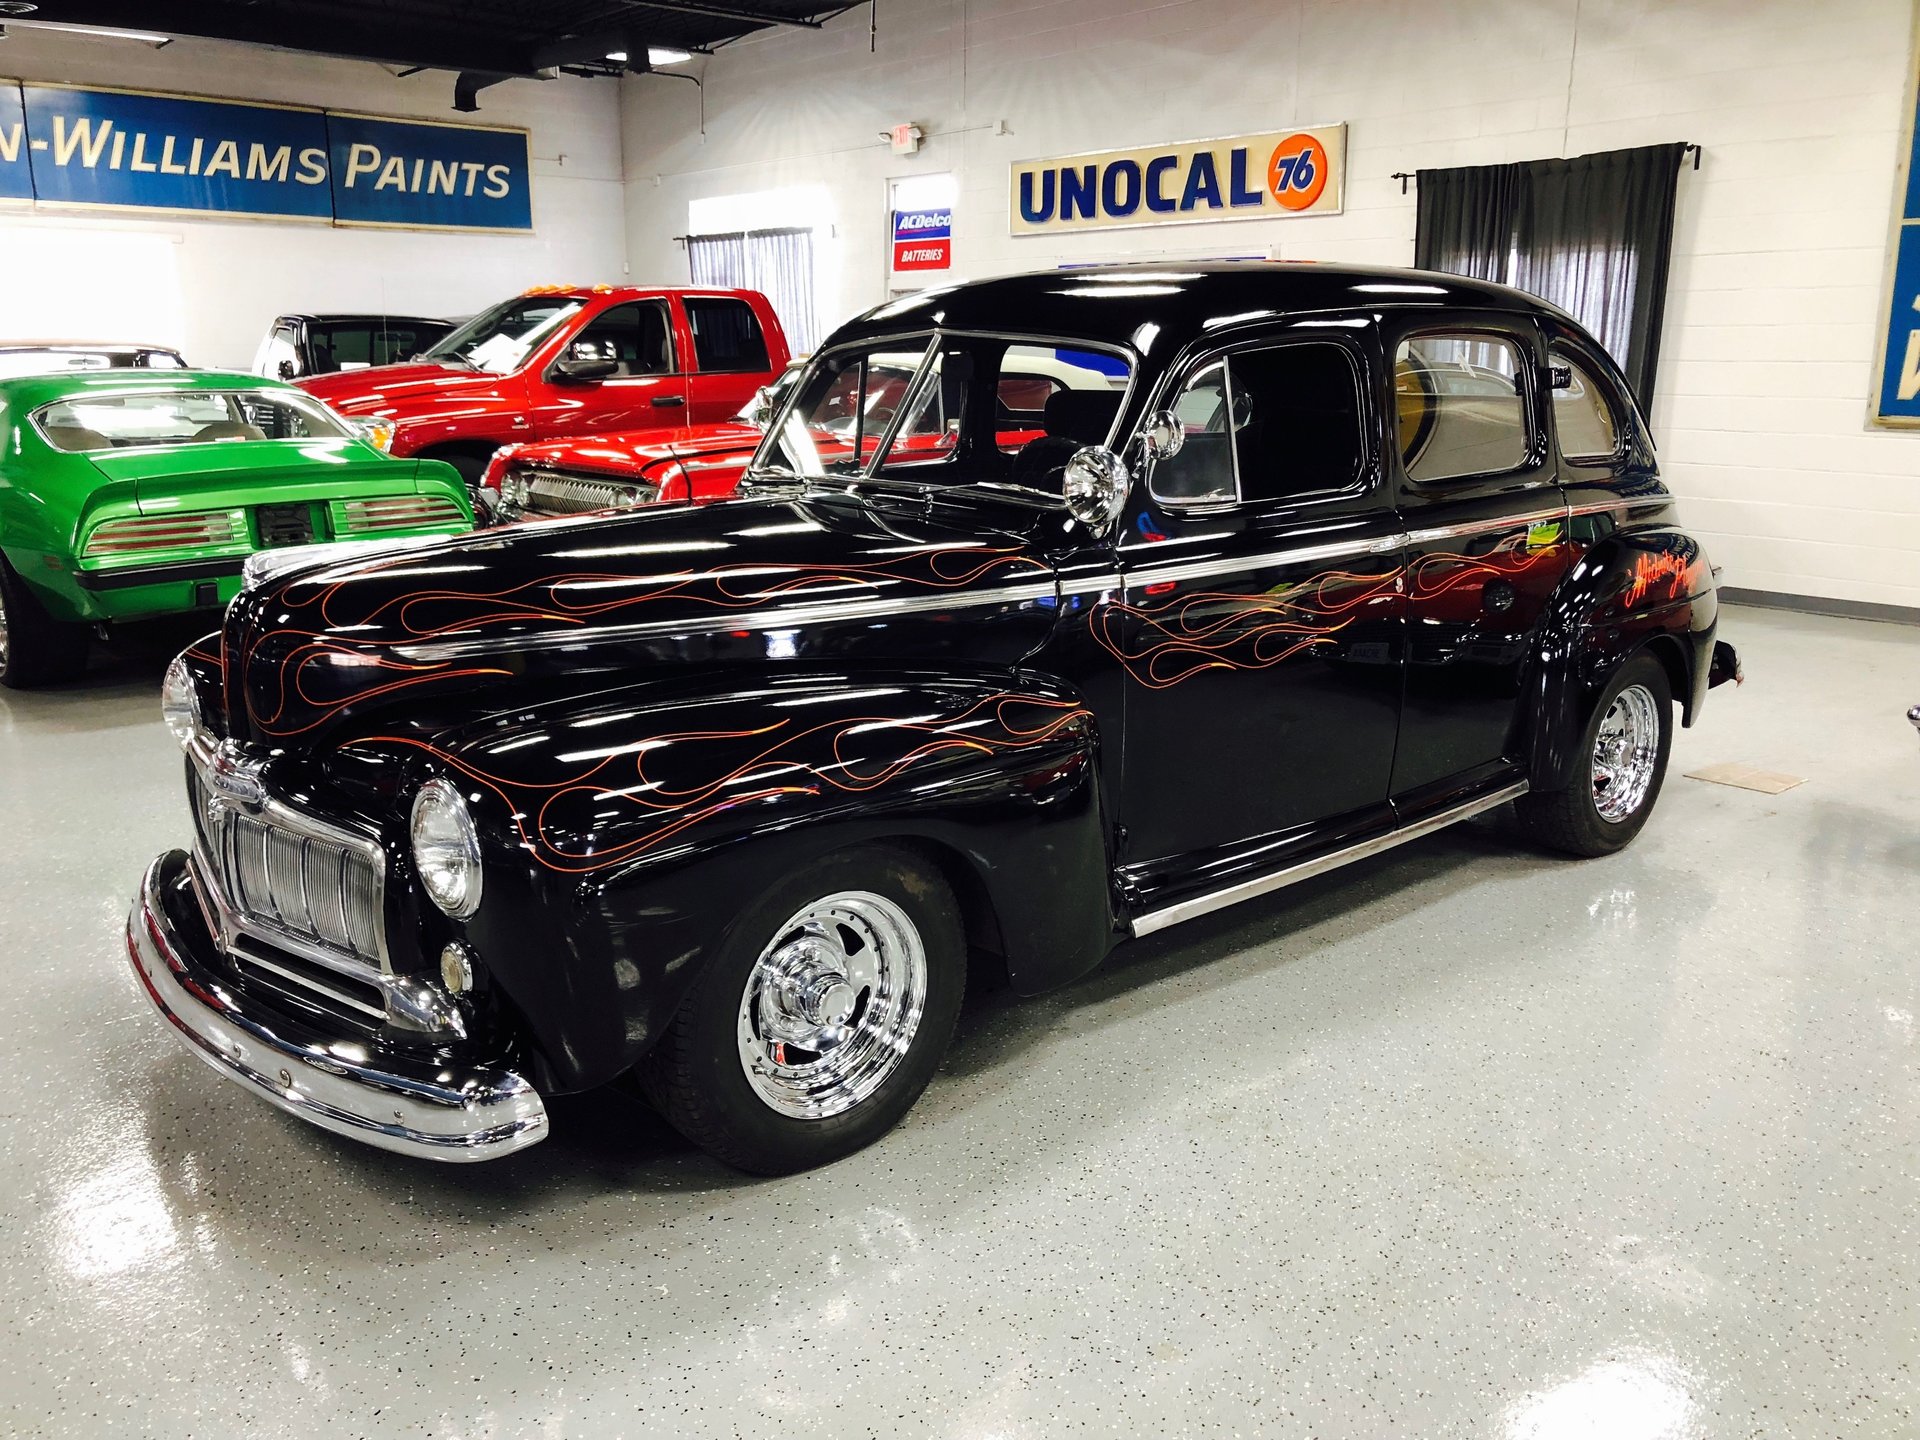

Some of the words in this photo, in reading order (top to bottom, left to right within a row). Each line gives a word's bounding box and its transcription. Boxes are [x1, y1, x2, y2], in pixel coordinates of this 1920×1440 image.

[344, 143, 510, 198] PAINTS
[1020, 147, 1263, 222] UNOCAL
[1277, 149, 1315, 192] 76
[899, 213, 951, 230] ACDelco
[901, 248, 943, 262] BATTERIES
